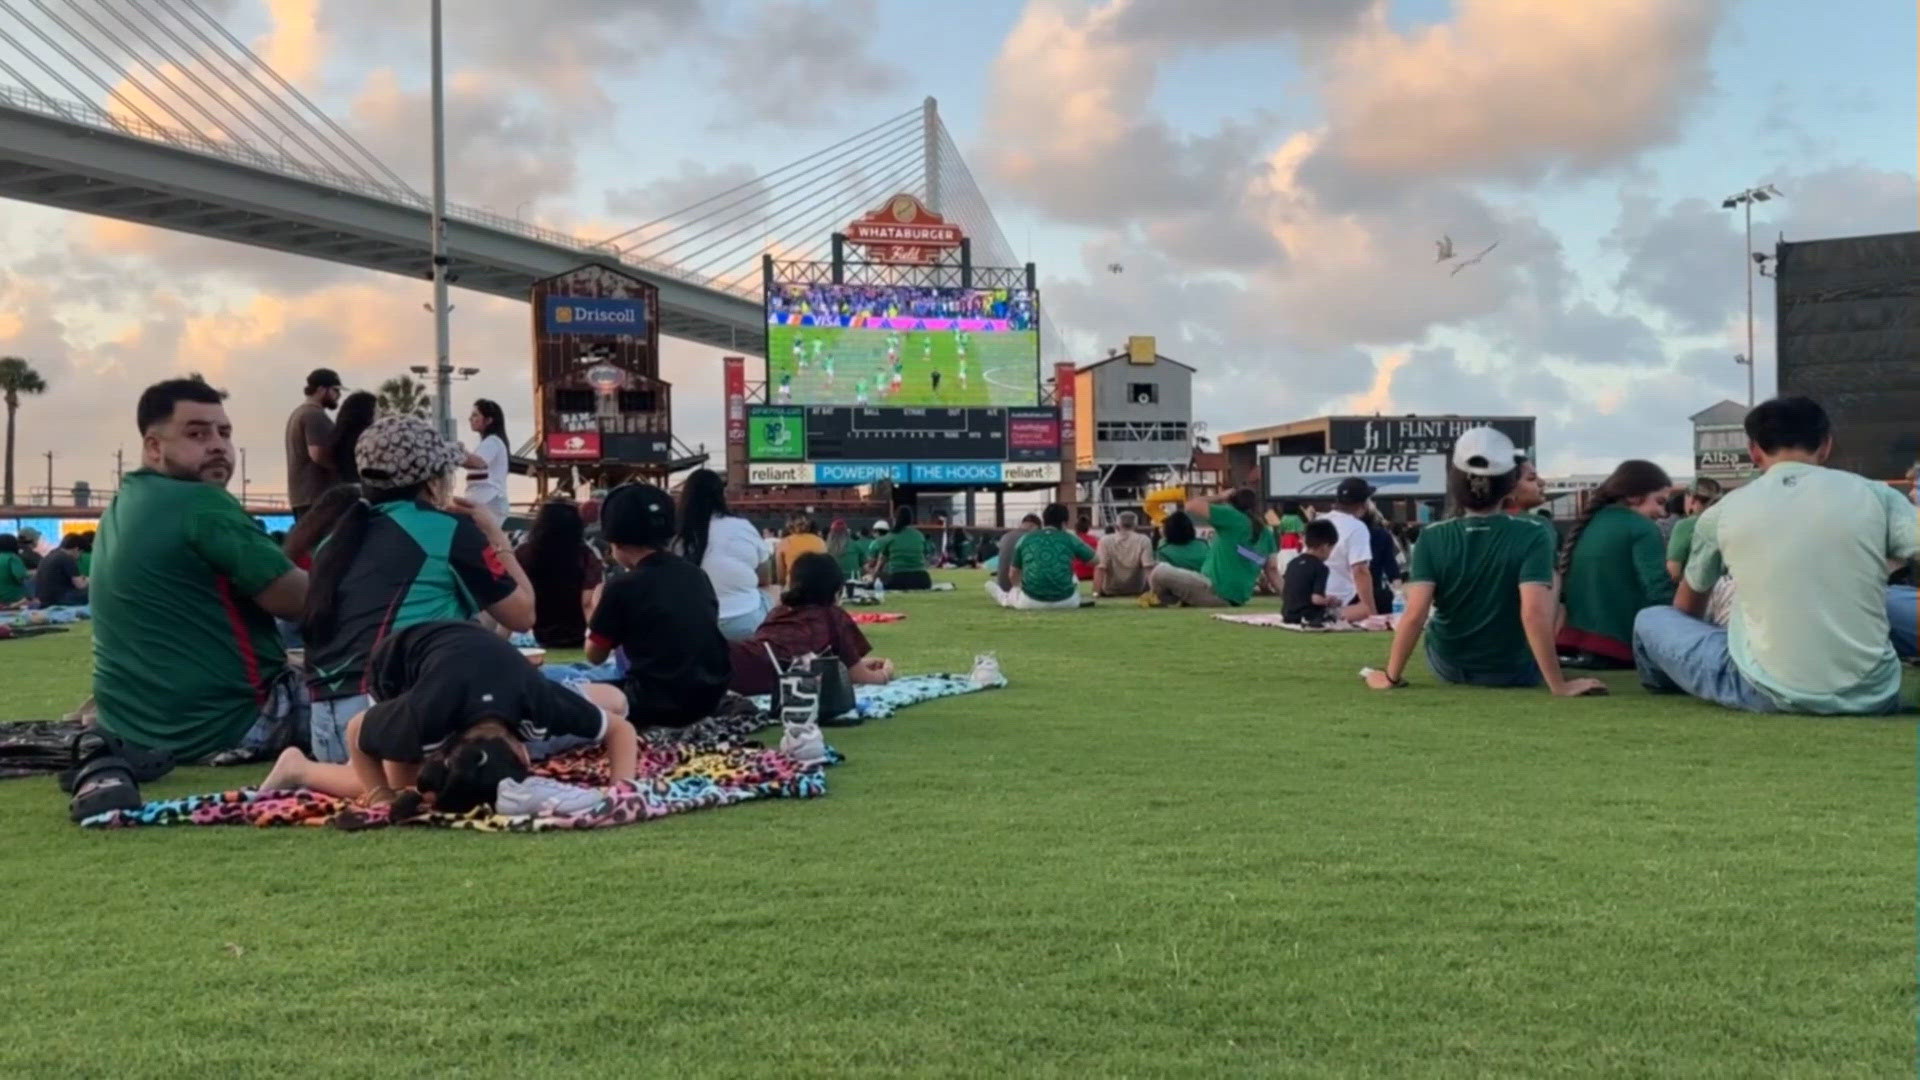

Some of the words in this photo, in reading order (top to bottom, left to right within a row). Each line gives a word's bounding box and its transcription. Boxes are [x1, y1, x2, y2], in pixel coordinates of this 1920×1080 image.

[858, 226, 954, 240] WHATABURGER
[890, 246, 921, 260] Field
[574, 307, 635, 323] Driscoll
[1399, 421, 1446, 438] FLINT
[1299, 454, 1420, 474] CHENIERE
[1701, 452, 1739, 463] Alba
[752, 467, 796, 480] reliant
[822, 466, 900, 480] POWERING
[915, 466, 942, 479] THE
[947, 466, 997, 479] HOOKS
[1005, 466, 1043, 479] reliant
